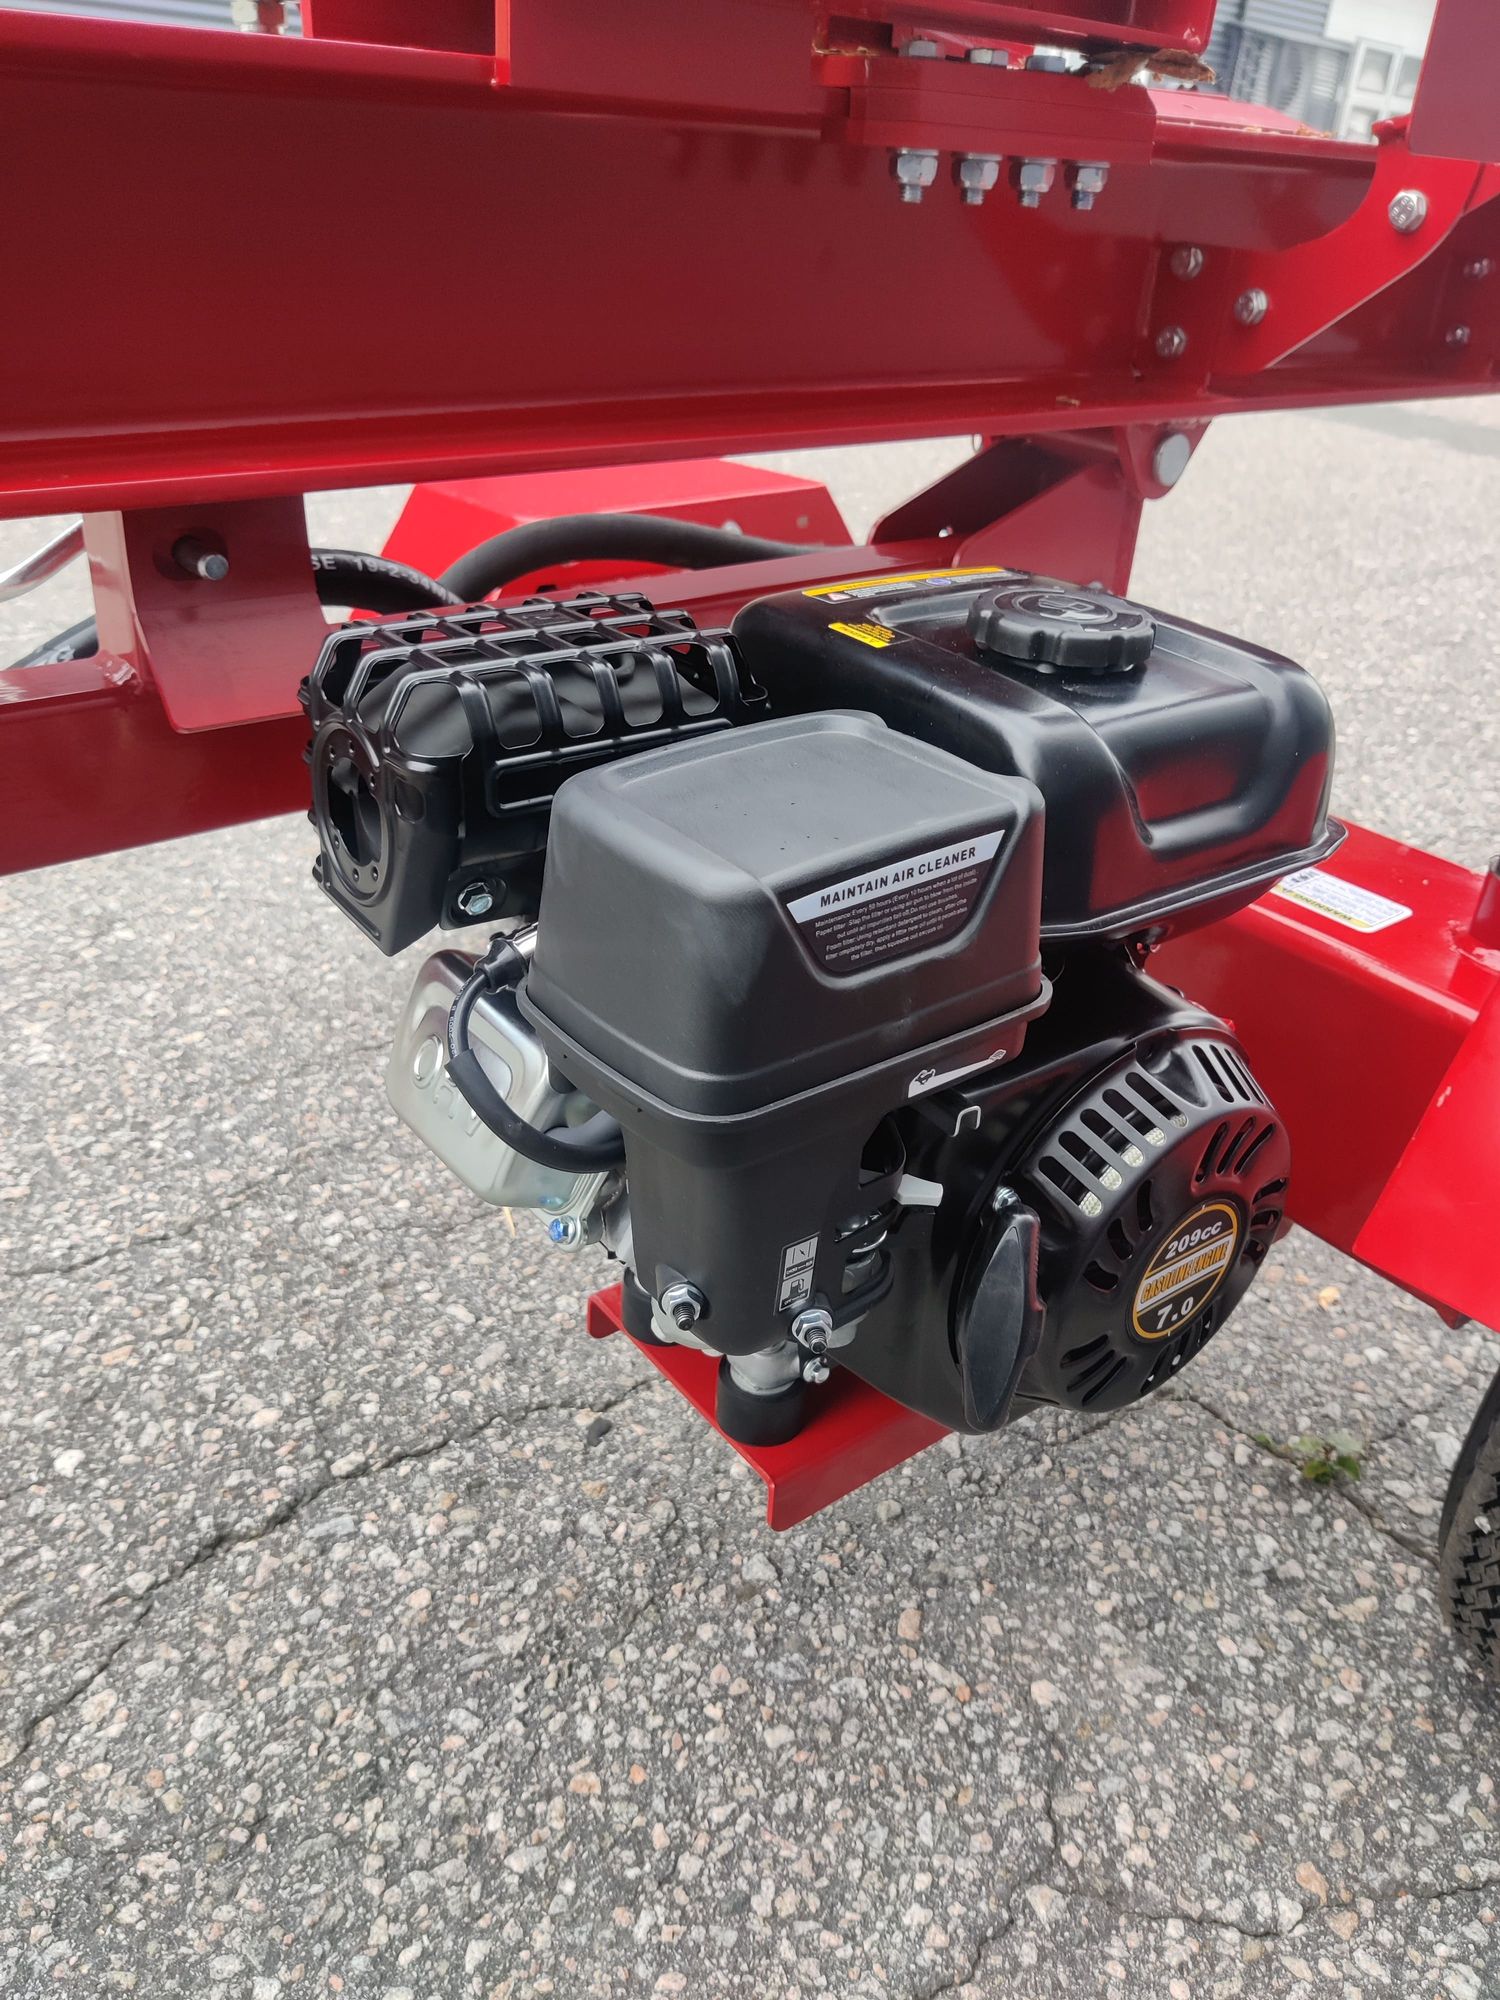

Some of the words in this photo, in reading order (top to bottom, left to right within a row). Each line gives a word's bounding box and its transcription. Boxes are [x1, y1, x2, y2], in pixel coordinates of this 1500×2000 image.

[820, 875, 889, 908] MAINTAIN
[892, 867, 915, 884] AIR
[917, 846, 976, 875] CLEANER
[1164, 1221, 1223, 1261] 209cc
[1156, 1296, 1194, 1330] 7.0
